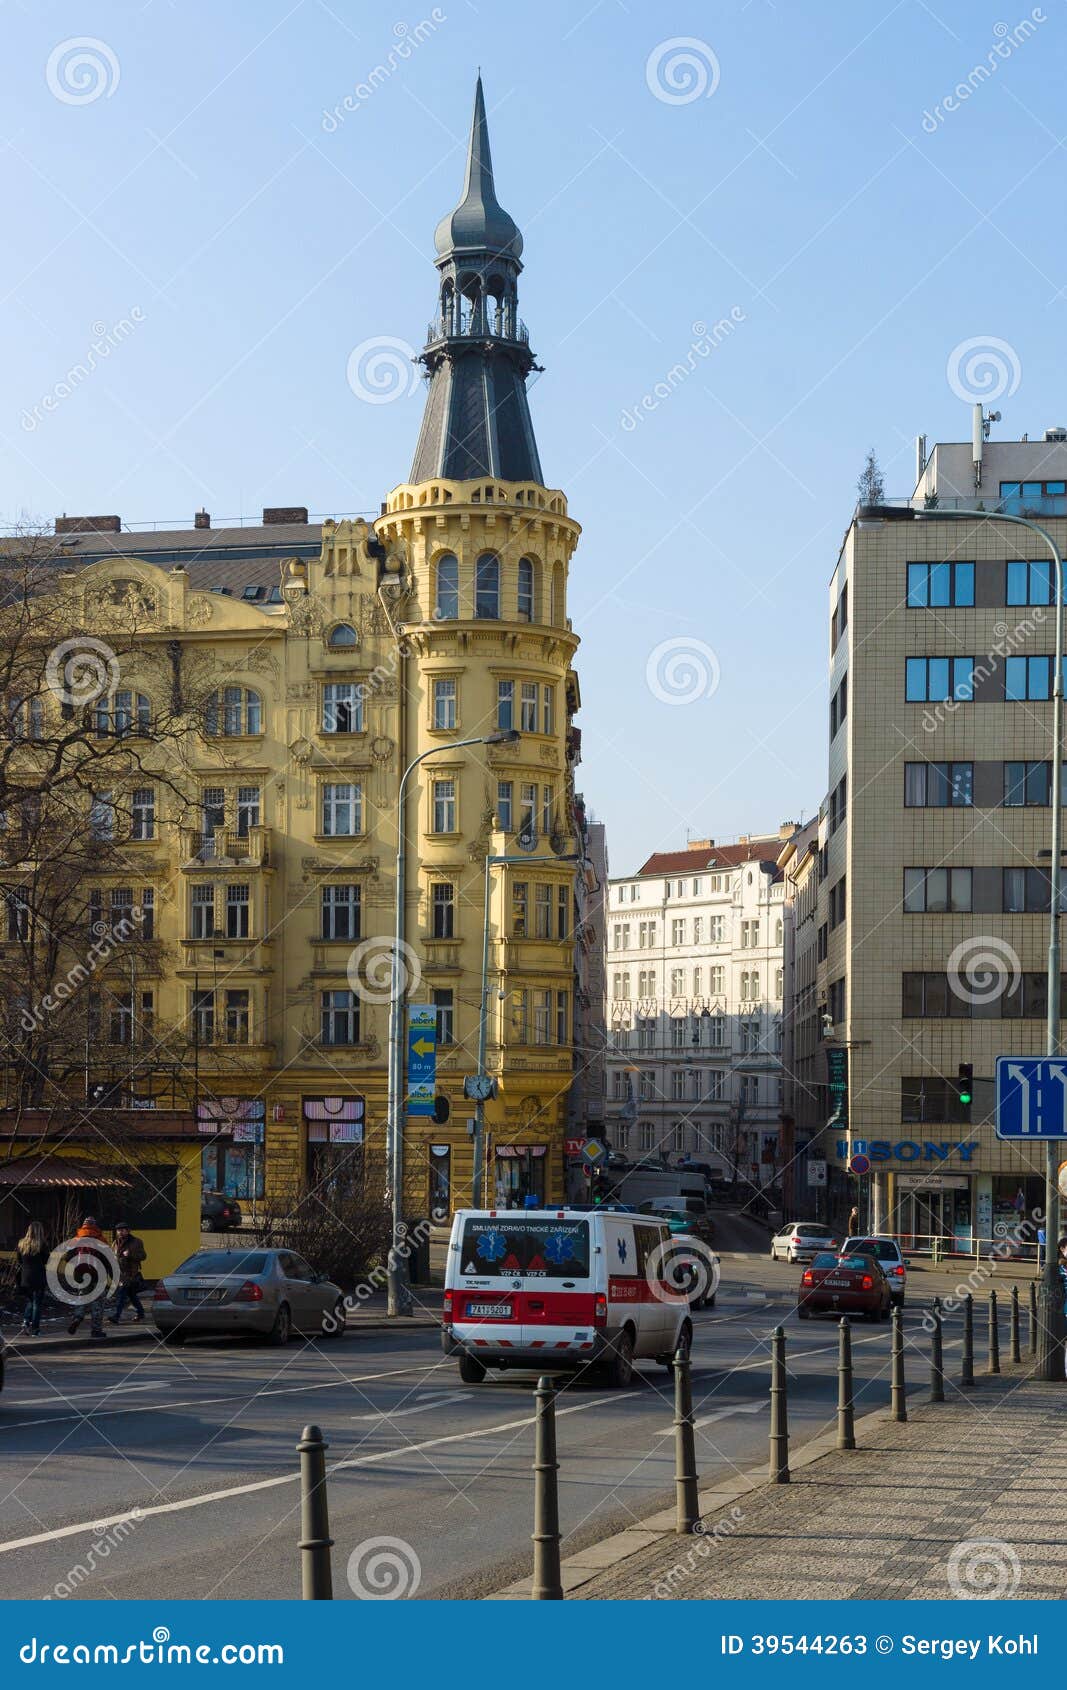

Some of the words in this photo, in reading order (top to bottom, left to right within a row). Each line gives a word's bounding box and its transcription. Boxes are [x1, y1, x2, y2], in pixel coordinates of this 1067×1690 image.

[410, 1016, 435, 1025] albert
[409, 1090, 433, 1099] albert
[566, 1140, 584, 1150] TV
[869, 1140, 978, 1162] SONY
